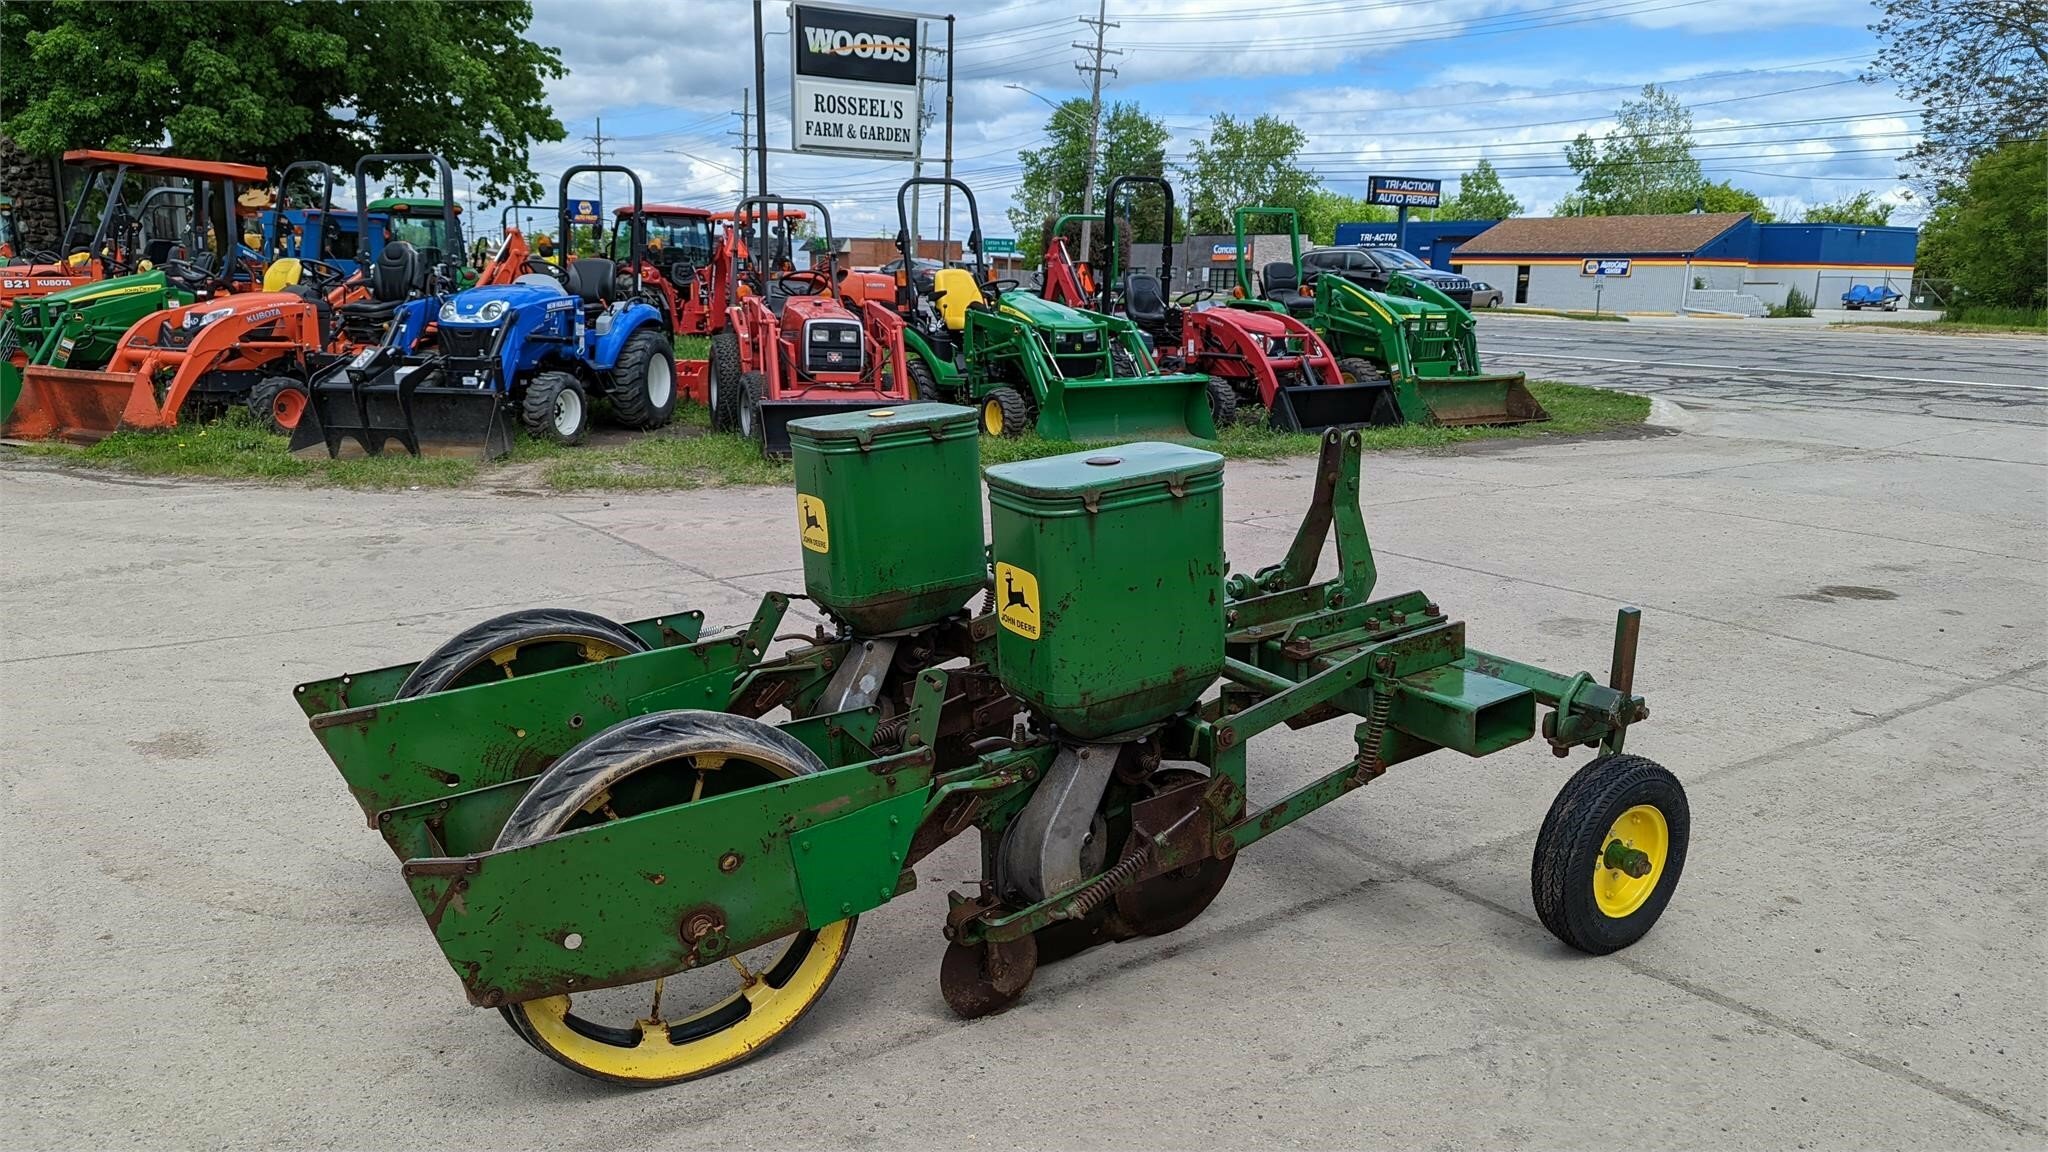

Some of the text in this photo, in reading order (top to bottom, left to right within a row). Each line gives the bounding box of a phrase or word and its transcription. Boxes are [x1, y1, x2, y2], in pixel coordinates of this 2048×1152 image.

[804, 26, 911, 62] WOODS
[814, 93, 903, 120] ROSSEEL'S
[805, 121, 911, 143] FARM & GARDEN
[1385, 180, 1435, 191] TRI-ACTION
[1378, 194, 1437, 205] AUTO REPAIR
[1360, 233, 1397, 242] TRI-ACTIO
[4, 279, 30, 288] B21
[246, 308, 282, 323] KUBOTA
[1001, 613, 1037, 635] JOHN DEERE
